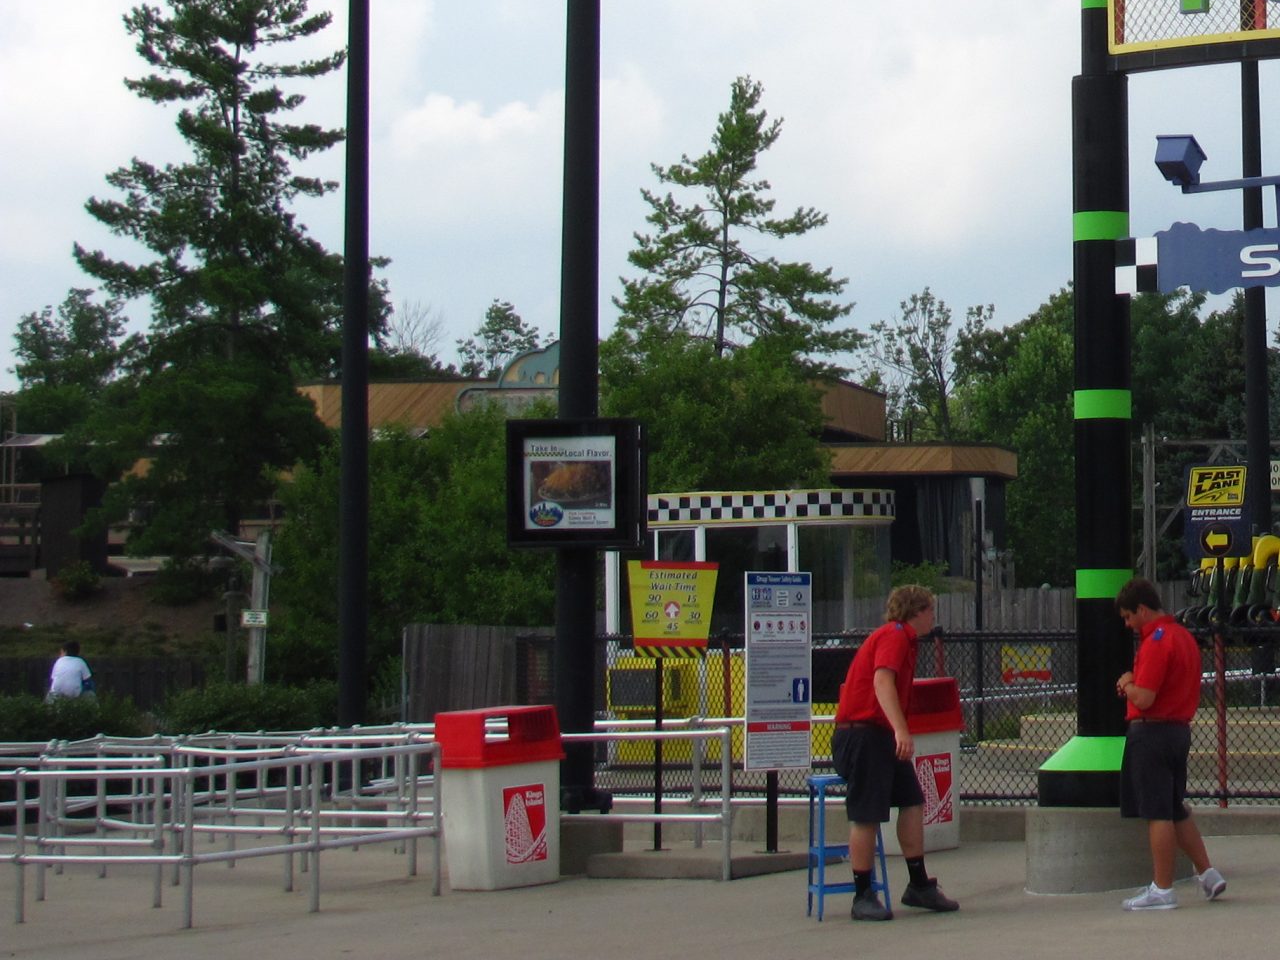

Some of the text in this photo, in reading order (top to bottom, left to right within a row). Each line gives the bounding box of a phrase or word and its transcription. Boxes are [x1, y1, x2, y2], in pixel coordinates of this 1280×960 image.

[564, 448, 585, 457] Local
[1197, 470, 1241, 482] FAST
[1194, 479, 1240, 496] LANE
[1191, 508, 1242, 517] ENTRANCE
[649, 571, 698, 580] Estimated
[651, 582, 697, 591] Wait Time
[648, 594, 661, 603] 90
[687, 594, 697, 603] 15
[645, 611, 659, 619] 60
[690, 611, 701, 620] 30
[666, 623, 678, 631] 45
